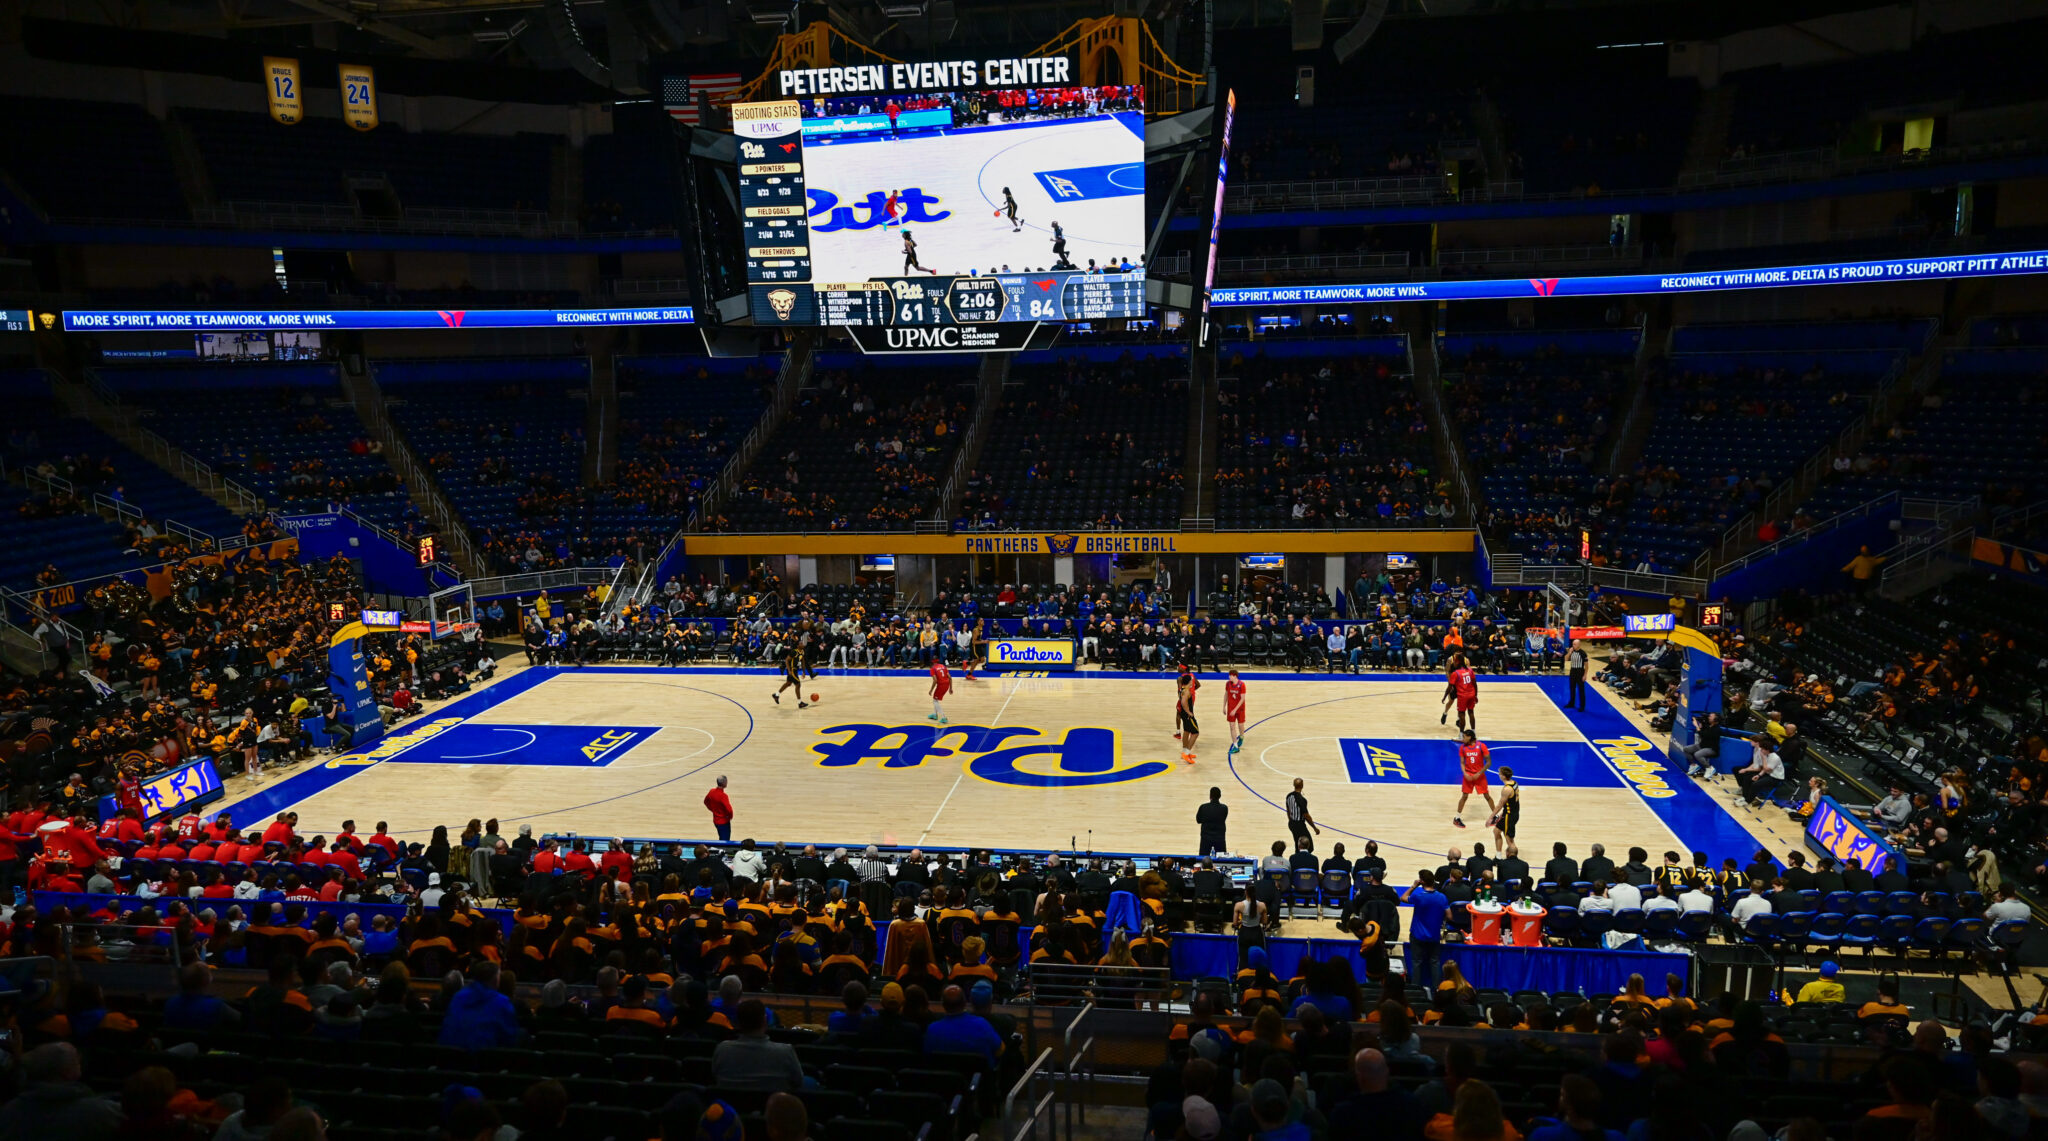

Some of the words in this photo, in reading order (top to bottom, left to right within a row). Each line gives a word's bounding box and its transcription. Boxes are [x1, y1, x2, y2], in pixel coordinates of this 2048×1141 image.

[272, 68, 292, 76] BRUCE
[344, 74, 370, 83] JOHNSON
[780, 65, 885, 96] PETERSEN
[892, 60, 977, 90] EVENTS
[984, 56, 1070, 85] CENTER
[274, 76, 295, 99] 12
[347, 83, 370, 105] 24
[734, 107, 772, 120] SHOOTING
[774, 106, 798, 118] STATS
[752, 122, 782, 133] UPMC
[740, 142, 766, 158] Pitt
[1050, 176, 1084, 198] ACC
[1661, 275, 1722, 288] RECONNECT
[1724, 273, 1752, 285] WITH
[1754, 271, 1790, 283] MORE.
[1792, 269, 1826, 281] DELTA
[1828, 268, 1840, 279] IS
[1842, 264, 1883, 278] PROUD
[1886, 263, 1904, 275] TO
[1906, 260, 1965, 275] SUPPORT
[1968, 258, 1998, 271] PITT
[892, 280, 924, 300] Pitt
[956, 282, 968, 290] HAIL
[969, 282, 979, 290] TO
[980, 281, 995, 289] PITT
[1008, 287, 1024, 295] FOULS
[928, 289, 944, 297] FOULS
[1210, 292, 1236, 303] MORE
[1238, 292, 1271, 302] SPIRIT,
[1272, 290, 1301, 300] MORE
[1304, 288, 1364, 300] TEAMWORK,
[1366, 287, 1396, 298] MORE
[1398, 286, 1427, 297] WINS.
[933, 297, 938, 305] 7
[960, 292, 995, 308] 2:06
[901, 303, 923, 321] 61
[1030, 300, 1056, 318] 84
[1083, 304, 1114, 312] DAVIS-RAY
[72, 314, 110, 326] MORE
[112, 314, 154, 327] SPIRIT,
[156, 314, 192, 326] MORE
[194, 314, 266, 326] TEAMWORK,
[268, 314, 302, 325] MORE
[303, 314, 336, 325] WINS.
[557, 312, 607, 322] RECONNECT
[608, 312, 632, 322] WITH
[634, 311, 661, 321] MORE.
[663, 310, 689, 320] DELTA
[934, 315, 940, 323] 2
[959, 312, 969, 320] 2ND
[969, 312, 981, 320] HALF
[985, 310, 996, 320] 28
[8, 322, 17, 330] FLS
[18, 322, 22, 330] 3
[886, 327, 959, 348] UPMC
[421, 536, 433, 547] 2:06
[966, 537, 1038, 552] PANTHERS
[1086, 537, 1177, 552] BASKETBALL
[420, 547, 434, 563] 27
[49, 585, 76, 608] ZOO
[331, 610, 343, 620] 27
[1704, 606, 1721, 615] 2:06
[1704, 615, 1718, 624] 27
[996, 643, 1063, 661] Panthers
[1463, 675, 1471, 684] 10
[357, 697, 372, 708] UPMC
[360, 718, 382, 729] Clearview
[324, 717, 464, 769] Panthers
[580, 730, 632, 760] ACC
[810, 722, 1177, 789] Pitt
[1367, 744, 1410, 780] ACC
[1592, 736, 1678, 798] Panthers
[101, 826, 109, 834] 3
[179, 825, 192, 836] 24
[1669, 872, 1682, 885] 12
[1732, 874, 1742, 887] 7
